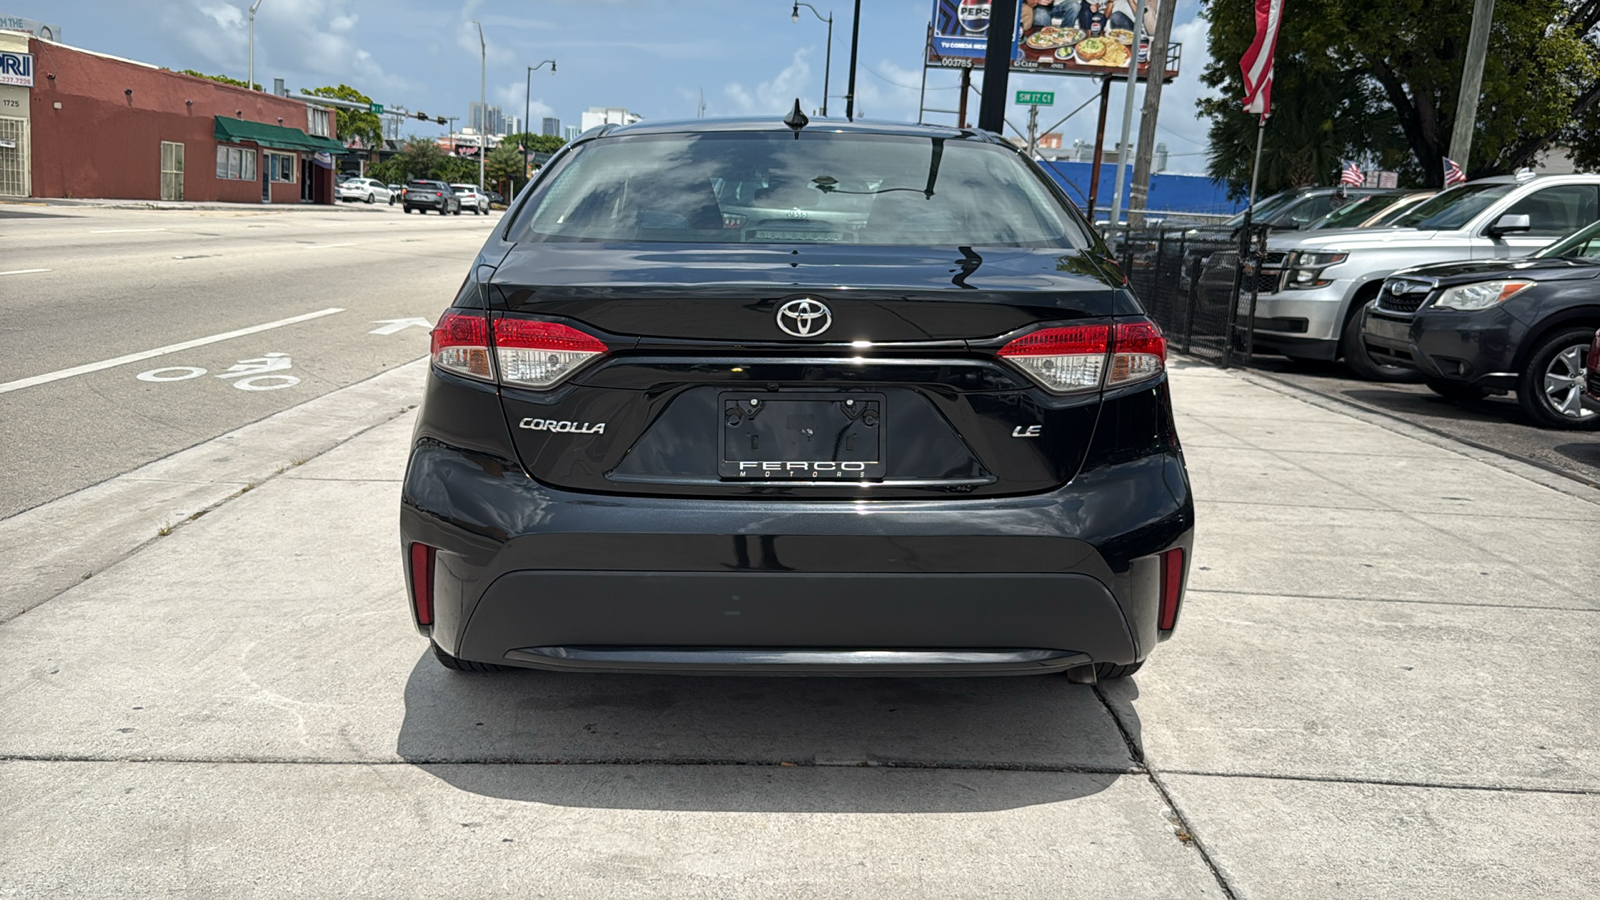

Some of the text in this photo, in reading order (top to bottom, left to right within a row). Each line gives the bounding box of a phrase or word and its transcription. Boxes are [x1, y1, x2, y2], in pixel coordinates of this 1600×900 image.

[960, 7, 990, 17] PEPS
[8, 18, 23, 28] THE
[941, 57, 973, 68] 003785
[1019, 93, 1031, 102] SW
[1032, 94, 1041, 102] 17
[3, 99, 20, 108] 1725
[519, 417, 606, 435] COROLLA
[1012, 424, 1042, 438] LE
[739, 461, 865, 471] FERCO
